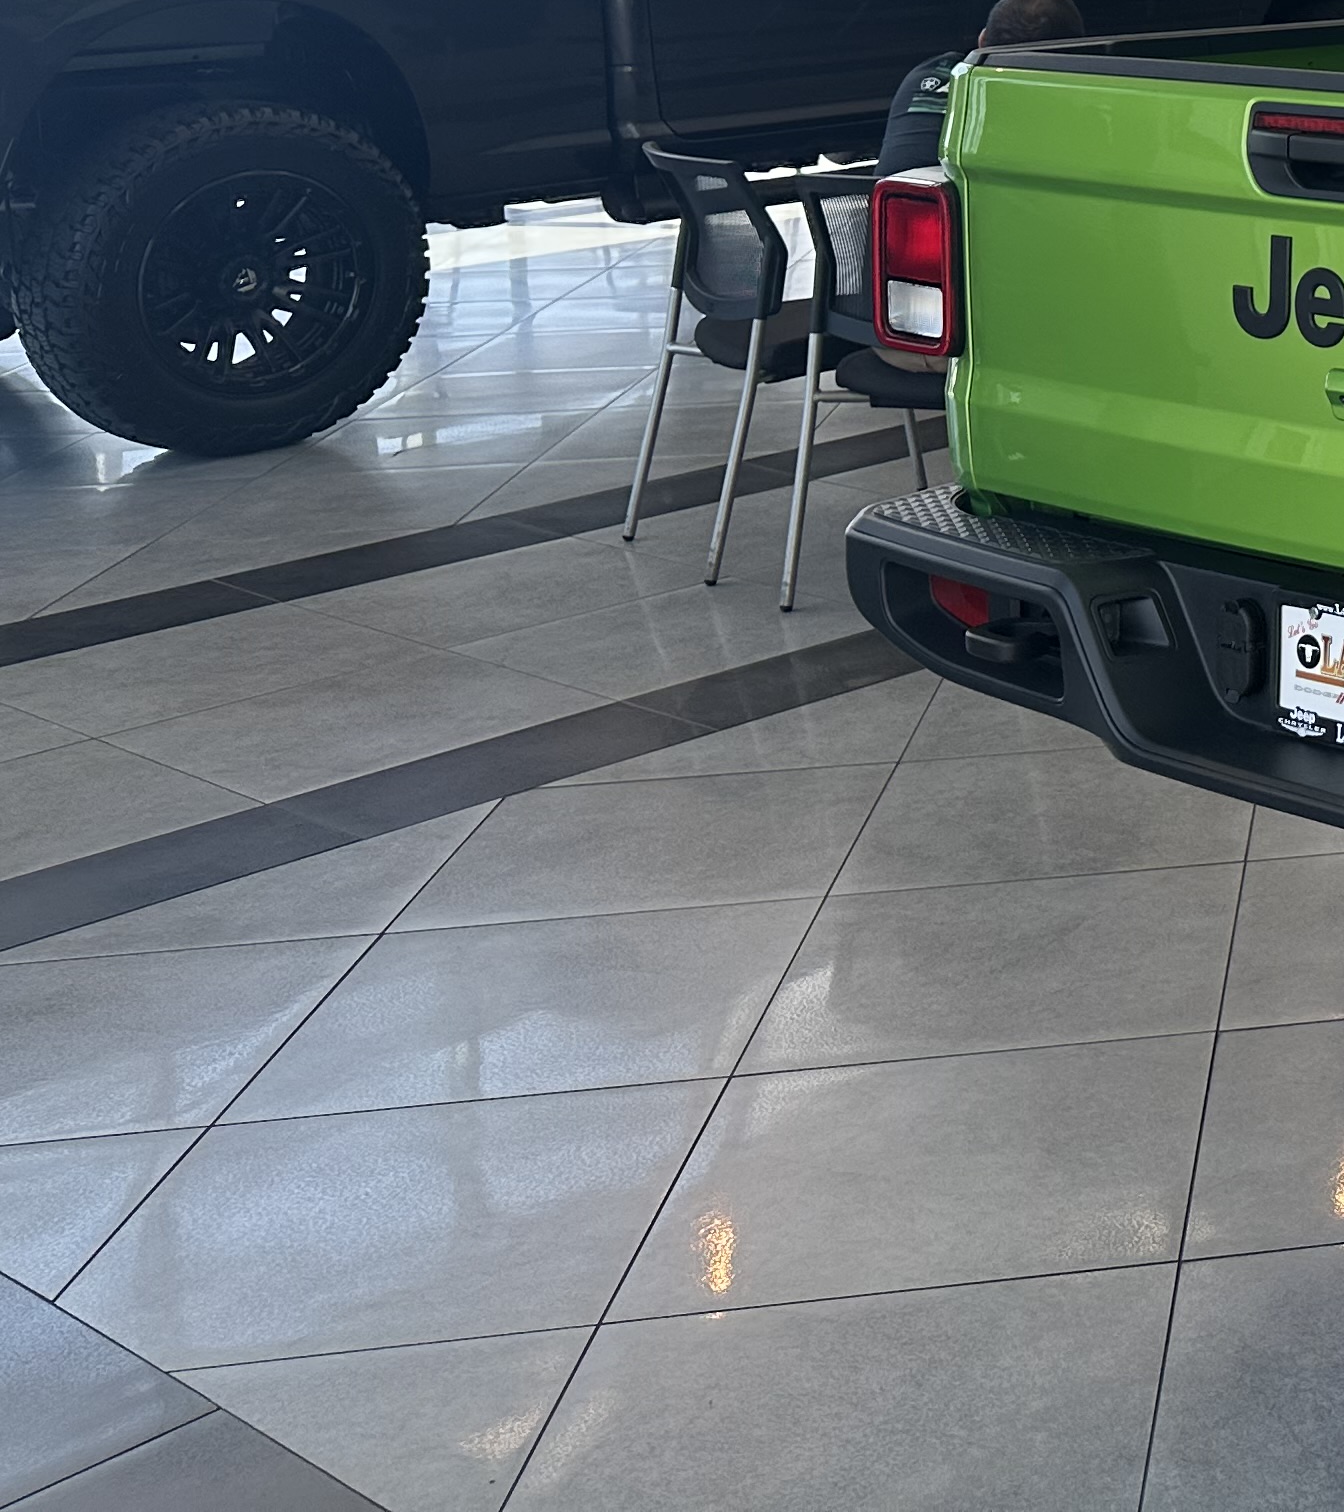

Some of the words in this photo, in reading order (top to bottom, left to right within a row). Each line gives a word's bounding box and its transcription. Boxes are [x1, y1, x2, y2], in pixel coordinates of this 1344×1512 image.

[1293, 684, 1337, 699] DODGE
[1289, 707, 1316, 725] Jeep
[1277, 717, 1327, 735] CHRYSLER
